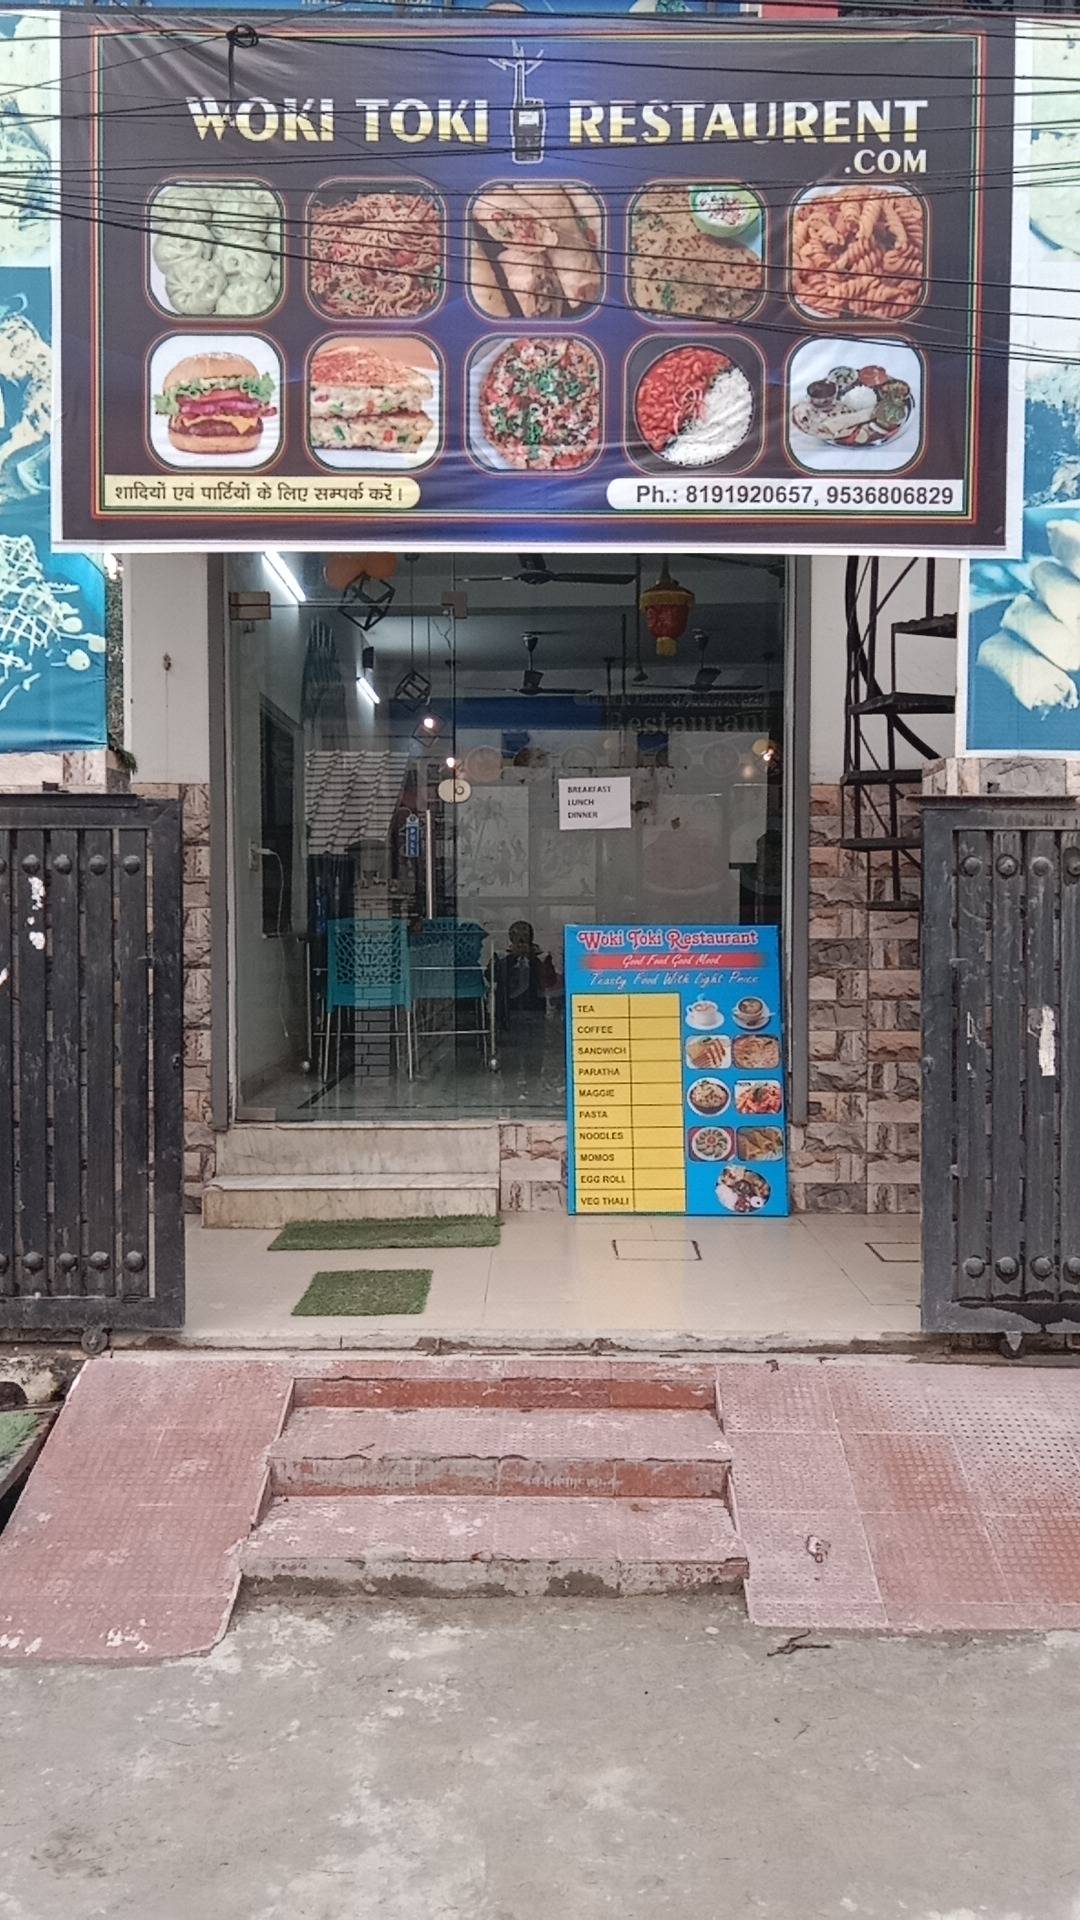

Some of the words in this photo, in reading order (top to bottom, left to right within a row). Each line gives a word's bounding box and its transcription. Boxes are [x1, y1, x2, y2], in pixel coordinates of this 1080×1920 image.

[186, 97, 333, 143] WOKI
[355, 98, 488, 143] TOKI
[568, 99, 928, 144] RESTAURENT
[843, 149, 927, 174] .COM
[115, 481, 166, 500] शादियों
[173, 483, 194, 501] एवं
[201, 481, 250, 500] पार्टियों
[256, 482, 272, 500] के
[277, 482, 308, 501] लिए
[314, 482, 364, 501] सम्पर्क
[636, 485, 677, 504] Ph.:
[686, 485, 819, 507] 8191920657,
[826, 487, 953, 505] 9536806829
[567, 786, 611, 794] BREAKFAST
[578, 930, 624, 950] Woki
[628, 929, 662, 949] Toki
[665, 930, 758, 951] Restaurant
[622, 955, 645, 969] Good
[672, 954, 694, 968] Good
[577, 1005, 595, 1013] TEA
[577, 1026, 613, 1034] COFFEE
[577, 1047, 627, 1055] SANDWICH
[578, 1068, 620, 1076] PARATHA
[578, 1089, 615, 1097] MAGGIE
[579, 1132, 624, 1140] NOODLES
[580, 1154, 615, 1162] MOMOS
[580, 1175, 600, 1183] EGG
[602, 1175, 626, 1183] ROLL
[580, 1197, 600, 1205] VEG
[602, 1197, 629, 1205] THALI
